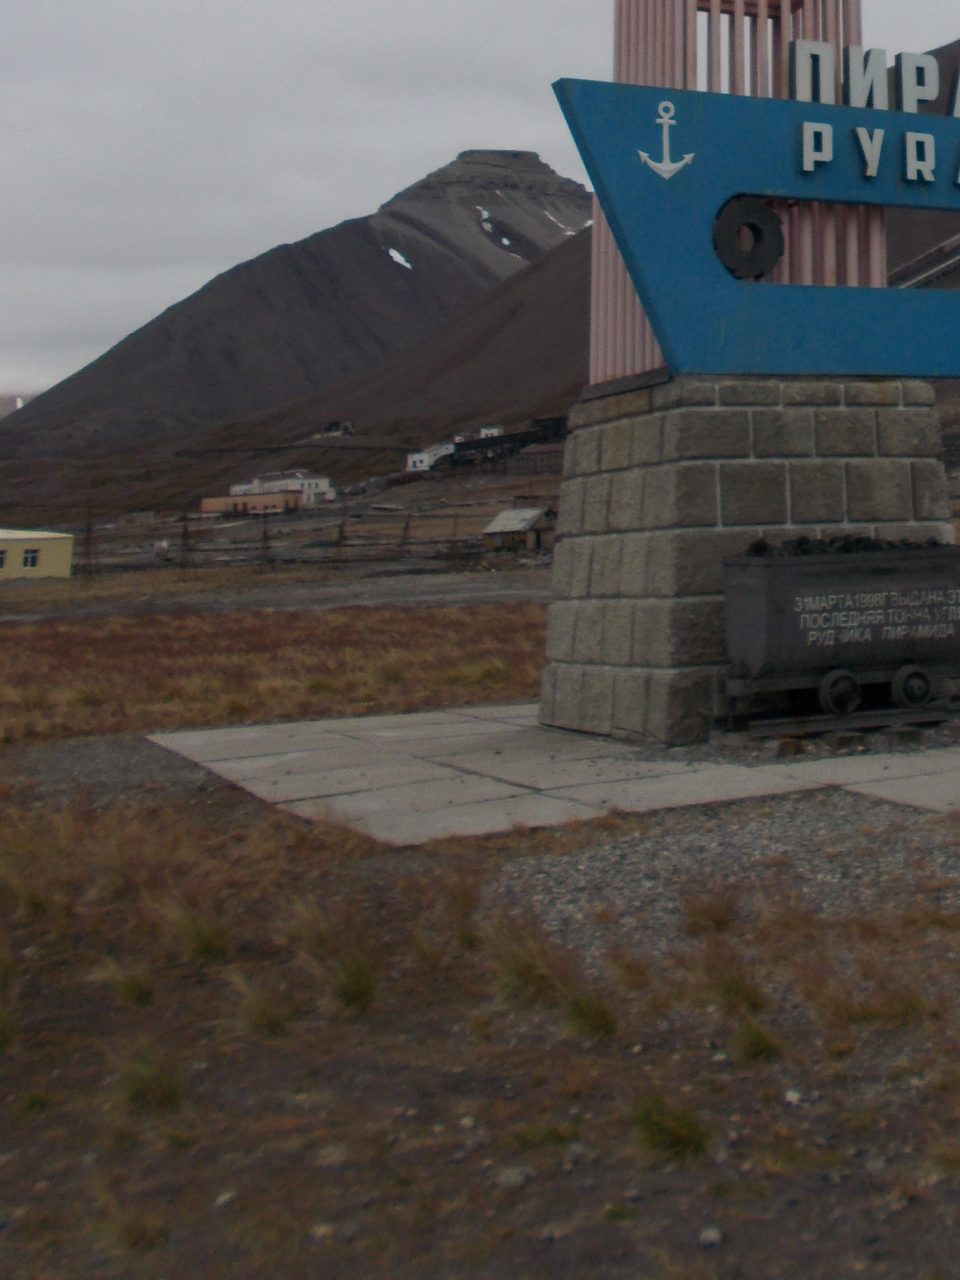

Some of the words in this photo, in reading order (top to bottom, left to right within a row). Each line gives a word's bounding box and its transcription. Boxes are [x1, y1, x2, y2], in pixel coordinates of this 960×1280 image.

[808, 594, 854, 612] МАРТА
[800, 610, 884, 629] ПОСЛЕДНЯЯ
[882, 624, 955, 639] ПИРАМИДА
